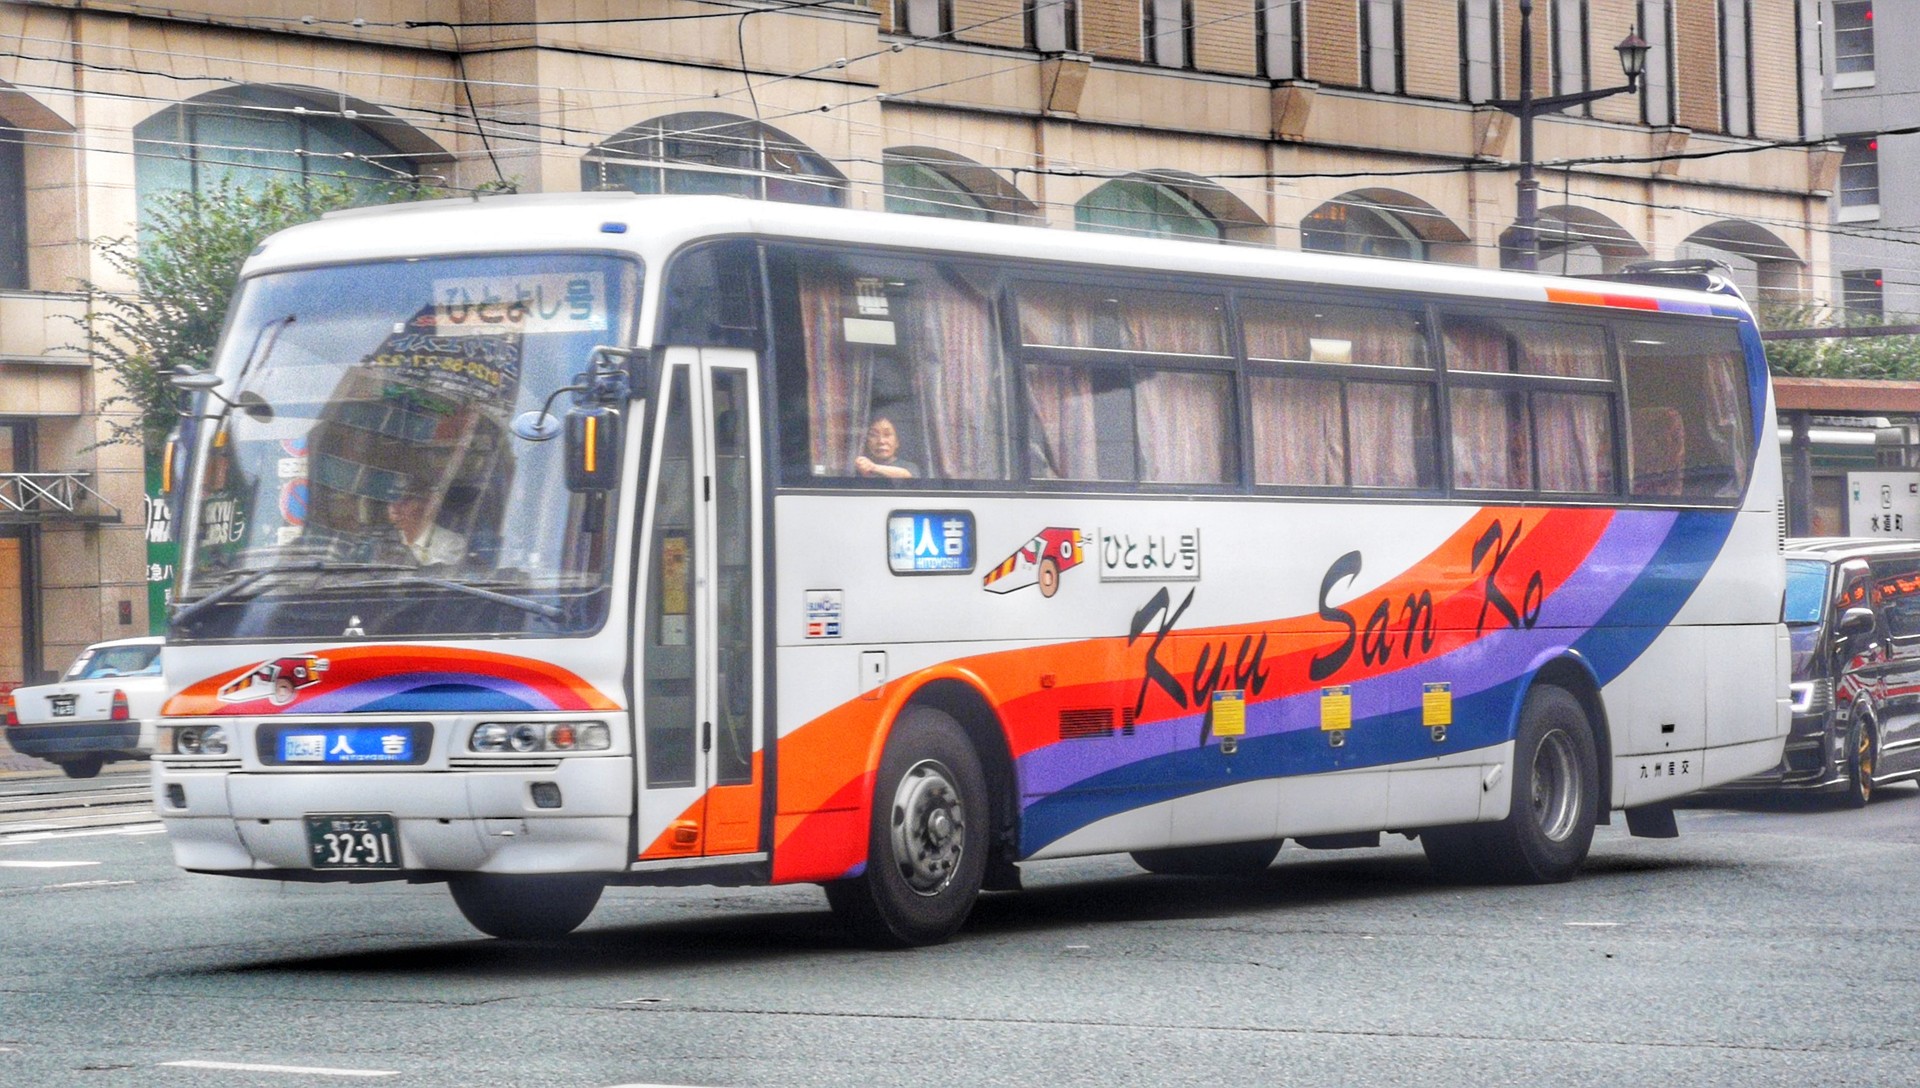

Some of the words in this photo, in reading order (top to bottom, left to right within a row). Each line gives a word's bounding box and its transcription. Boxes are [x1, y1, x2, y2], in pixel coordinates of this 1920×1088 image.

[445, 278, 594, 324] ひとよし号
[915, 518, 965, 556] 人吉
[1103, 534, 1197, 571] ひとよし号
[1129, 586, 1270, 747] Kyu
[1309, 549, 1438, 682] San
[1471, 518, 1543, 637] Ko
[329, 735, 408, 754] 人吉
[323, 833, 393, 864] 32-91
